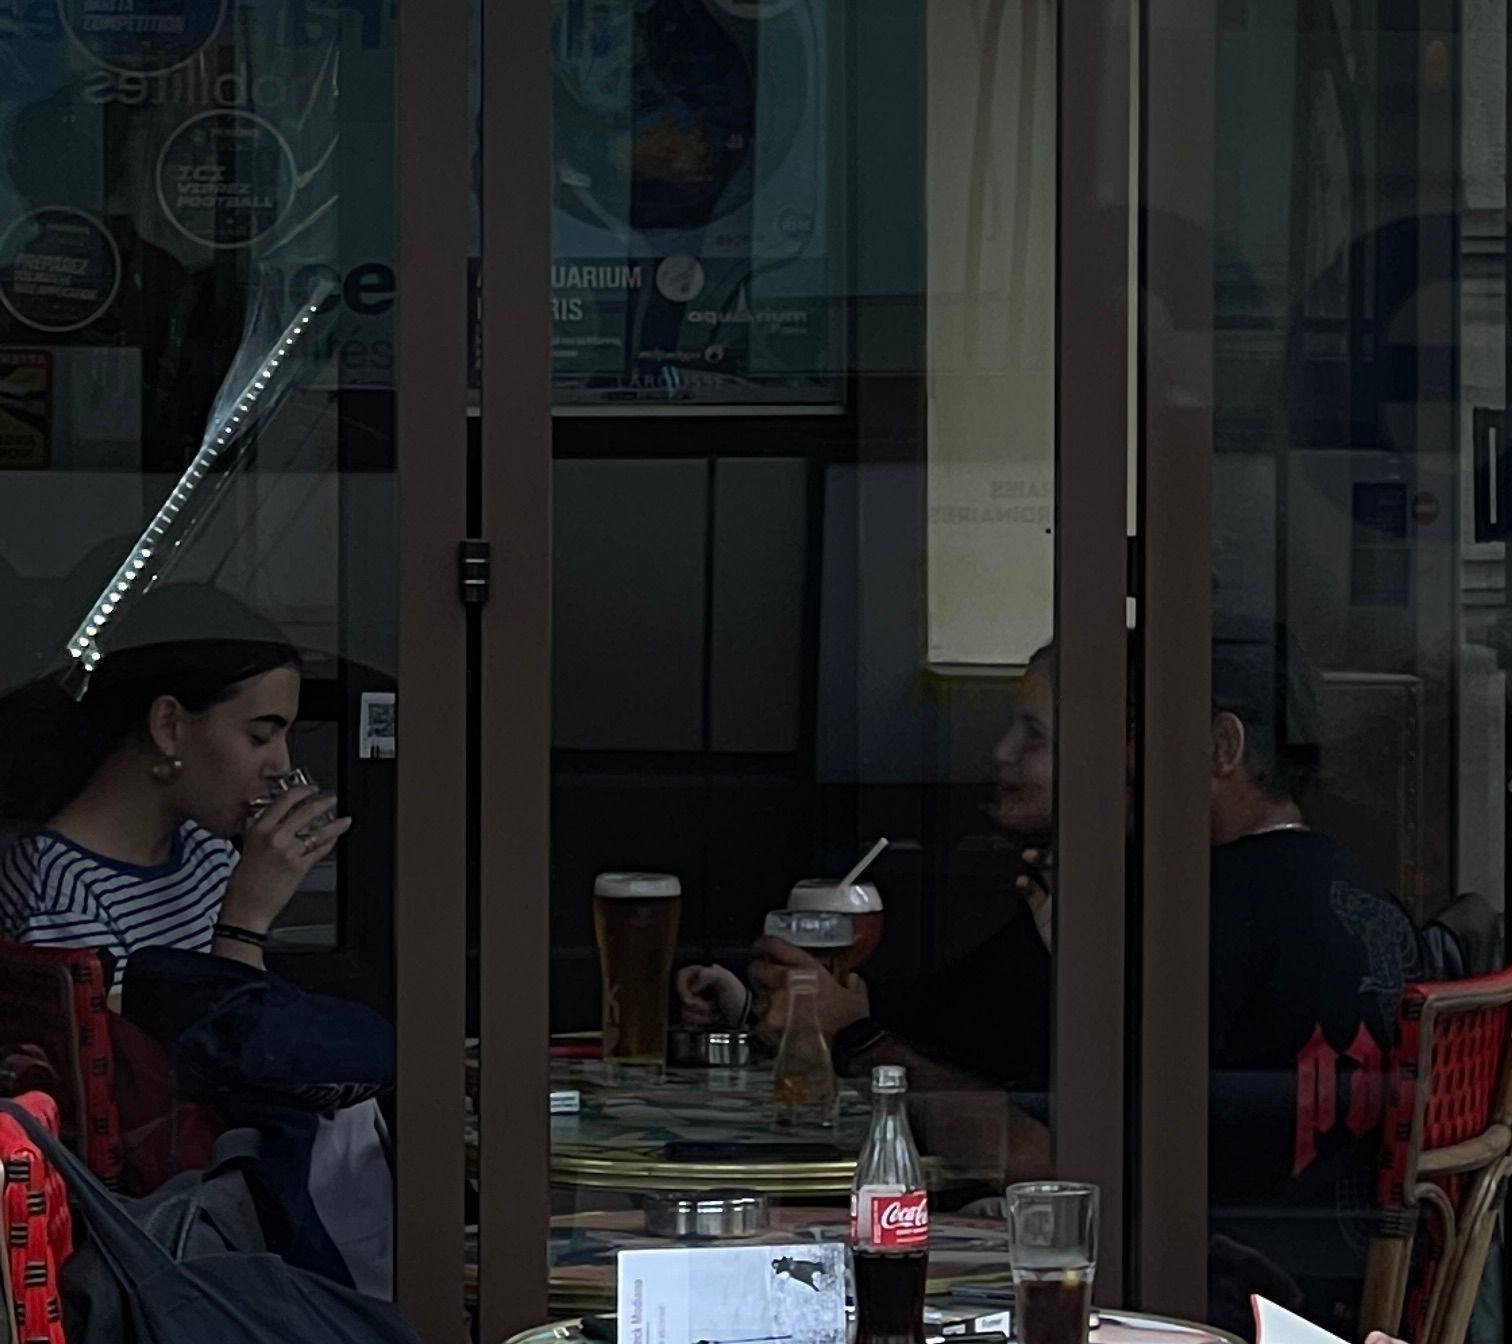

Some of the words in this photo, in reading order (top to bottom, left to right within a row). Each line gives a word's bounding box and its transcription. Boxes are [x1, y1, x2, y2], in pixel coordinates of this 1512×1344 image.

[176, 165, 226, 182] ICI
[176, 195, 274, 208] FOOTBALL
[551, 266, 642, 289] UARIUM
[551, 297, 584, 321] RIS
